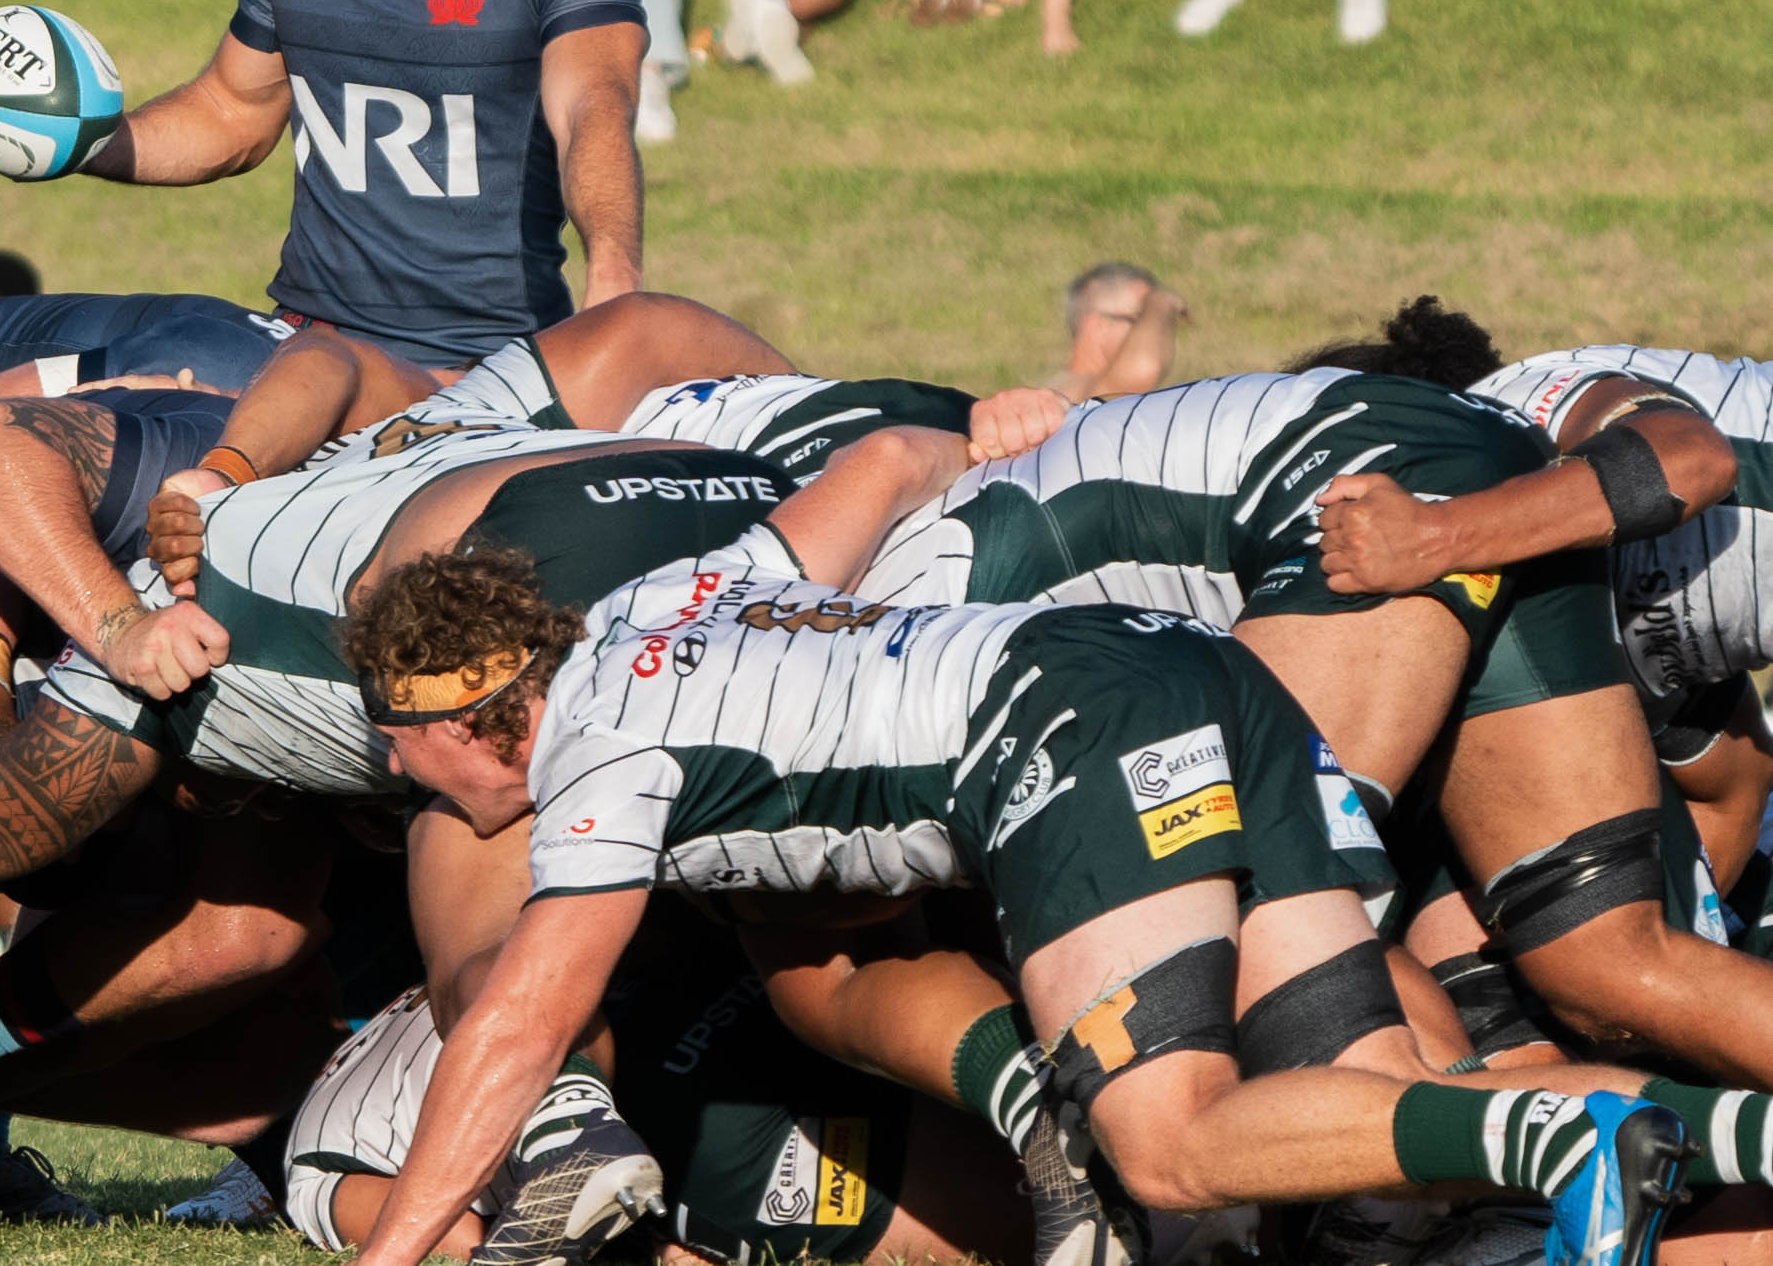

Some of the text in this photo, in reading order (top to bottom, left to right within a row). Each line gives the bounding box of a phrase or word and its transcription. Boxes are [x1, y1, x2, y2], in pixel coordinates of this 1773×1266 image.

[584, 476, 780, 504] UPSTATE
[1154, 803, 1205, 836] JAX
[663, 973, 764, 1075] UPSTA
